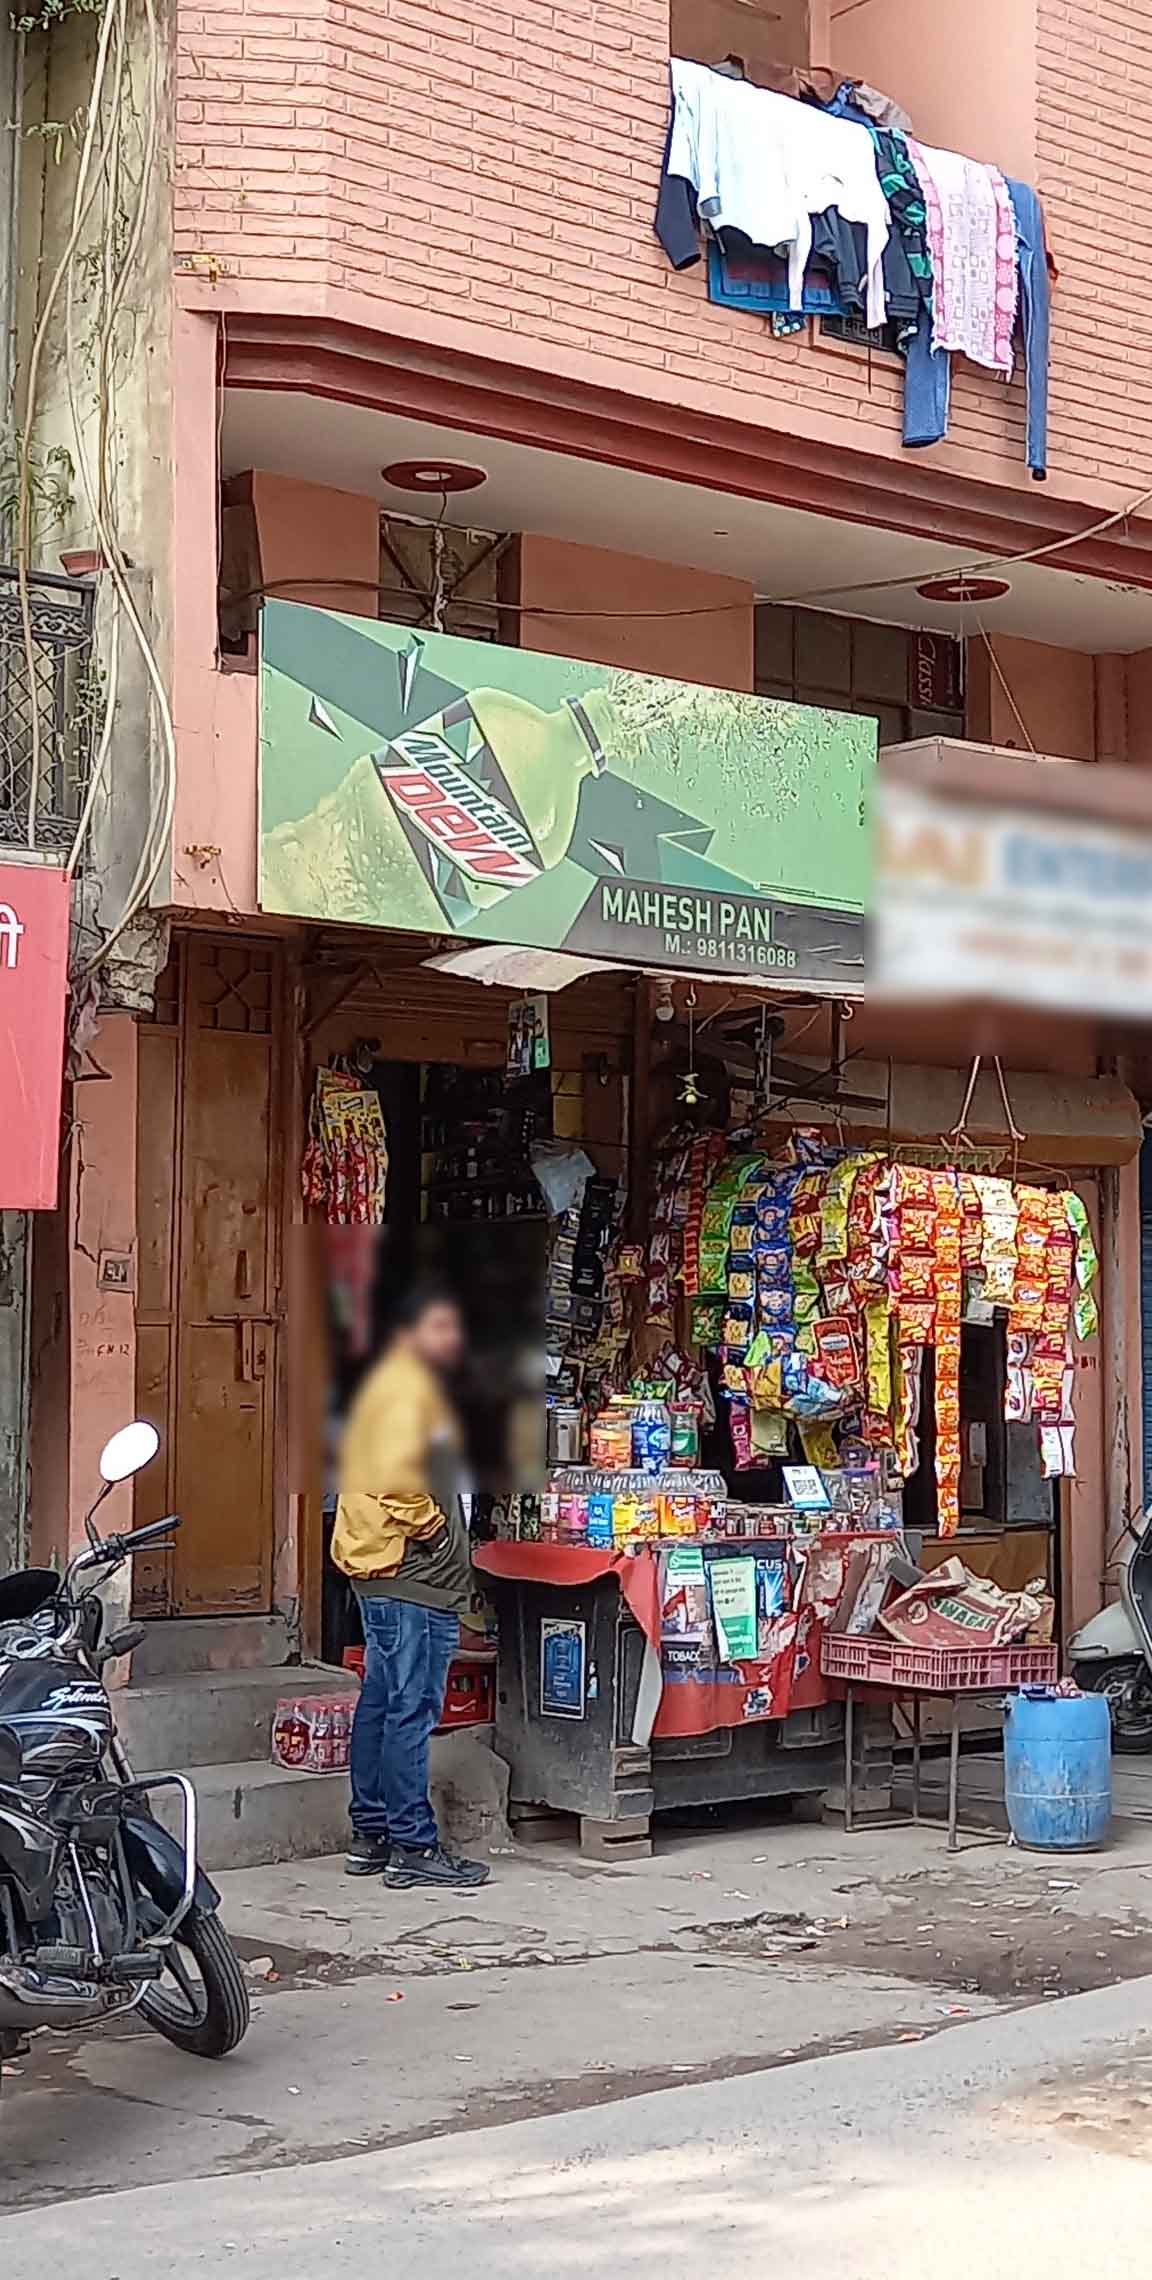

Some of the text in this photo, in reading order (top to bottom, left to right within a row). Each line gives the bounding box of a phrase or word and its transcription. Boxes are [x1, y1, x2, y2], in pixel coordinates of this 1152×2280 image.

[399, 738, 531, 850] Mountain
[602, 885, 771, 943] MAHESH PAN
[696, 937, 797, 969] 9811316088
